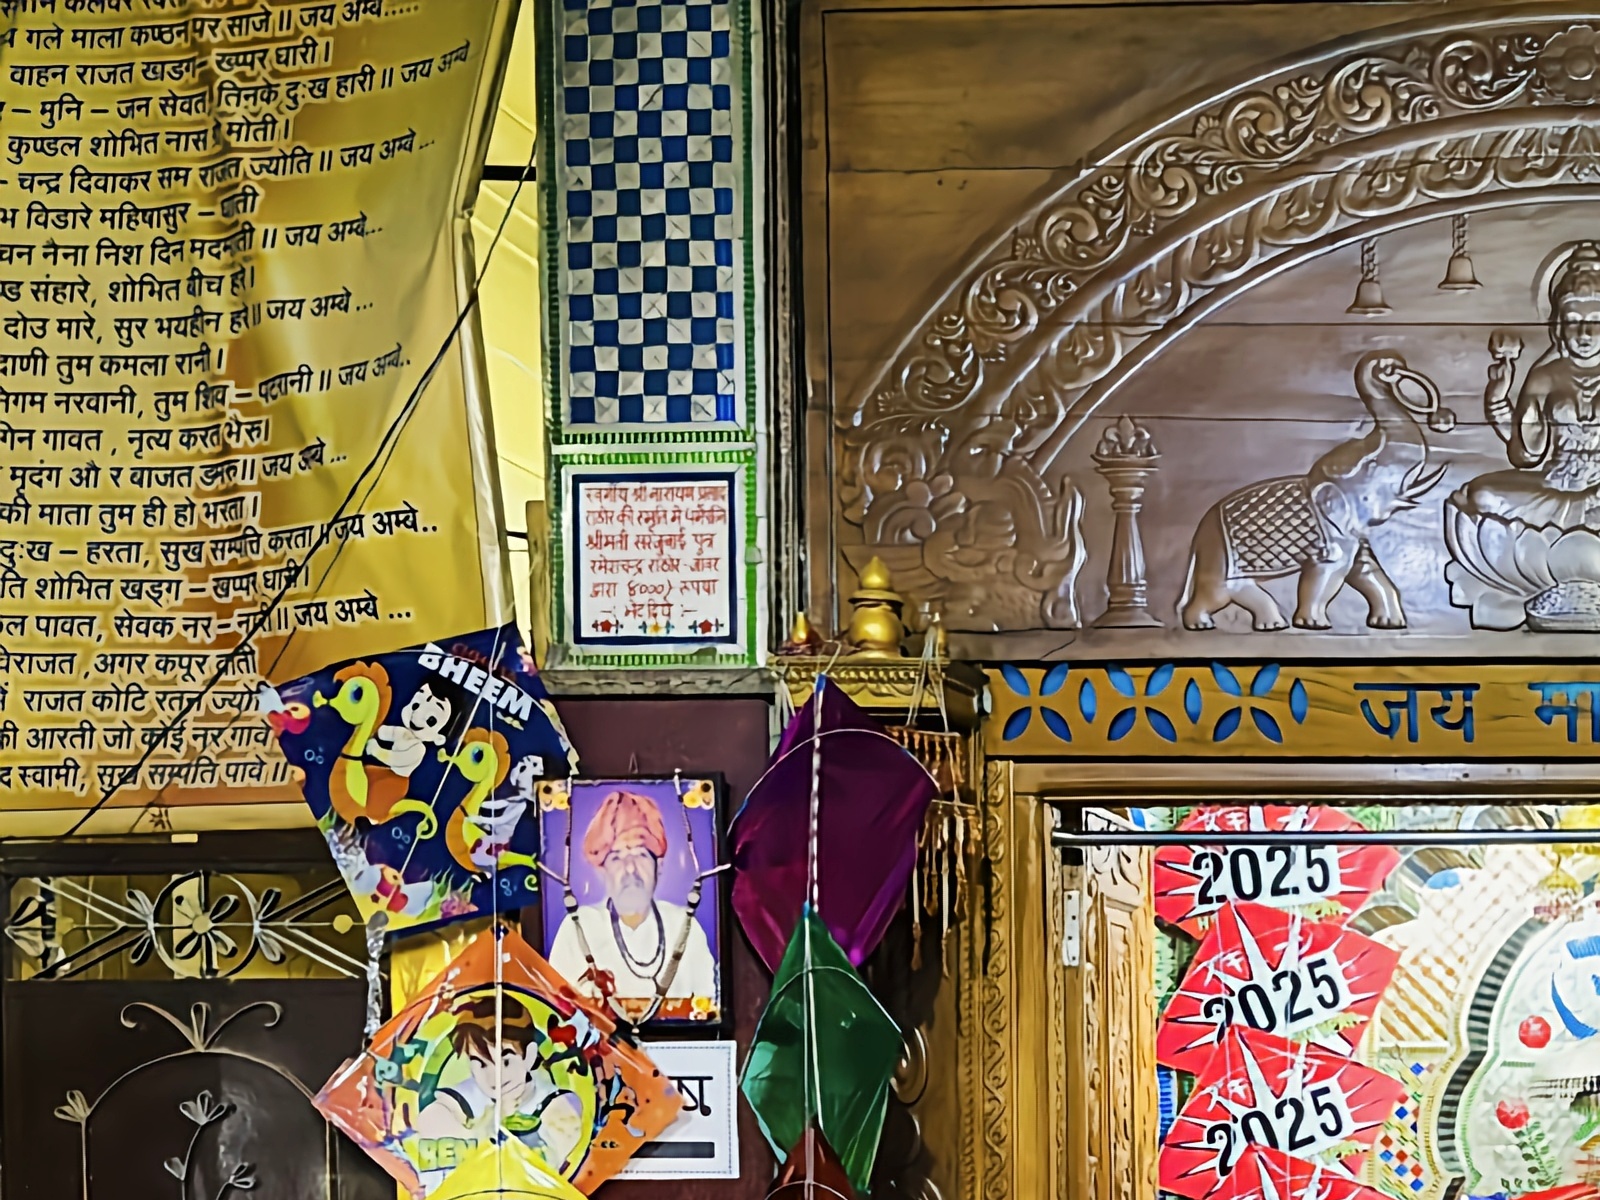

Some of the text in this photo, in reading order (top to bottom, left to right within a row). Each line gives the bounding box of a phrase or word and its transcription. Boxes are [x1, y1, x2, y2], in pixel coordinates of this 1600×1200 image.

[26, 23, 64, 49] गले
[72, 28, 125, 49] माला
[226, 5, 272, 36] साजे
[300, 4, 336, 27] जय
[10, 65, 69, 87] वाहन
[76, 62, 135, 85] राजत
[40, 93, 84, 129] मुनि
[117, 97, 153, 119] जन
[159, 89, 207, 116] सेवत
[336, 64, 375, 98] हारी
[401, 58, 434, 82] जय
[18, 173, 63, 194] चन्द्र
[70, 165, 152, 193] दिवाकर
[157, 167, 192, 189] सम
[340, 144, 374, 167] जय
[57, 356, 94, 384] तुम
[100, 355, 169, 376] कमला
[39, 505, 92, 525] माता
[99, 505, 136, 533] तुम
[143, 496, 167, 527] ही
[174, 497, 195, 527] हो
[203, 497, 245, 523] भरता
[617, 504, 633, 526] की
[160, 541, 205, 571] सुख
[114, 609, 176, 637] सेवक
[183, 617, 212, 638] नर
[294, 602, 328, 626] जय
[418, 641, 533, 721] BHEEM
[1353, 682, 1480, 743] जय
[27, 720, 96, 749] आरती
[103, 720, 134, 749] जो
[231, 719, 273, 746] गावे
[226, 755, 267, 782] पावे
[1193, 845, 1330, 905] 2025
[1203, 957, 1340, 1045] 2025
[1206, 1089, 1343, 1177] 2025
